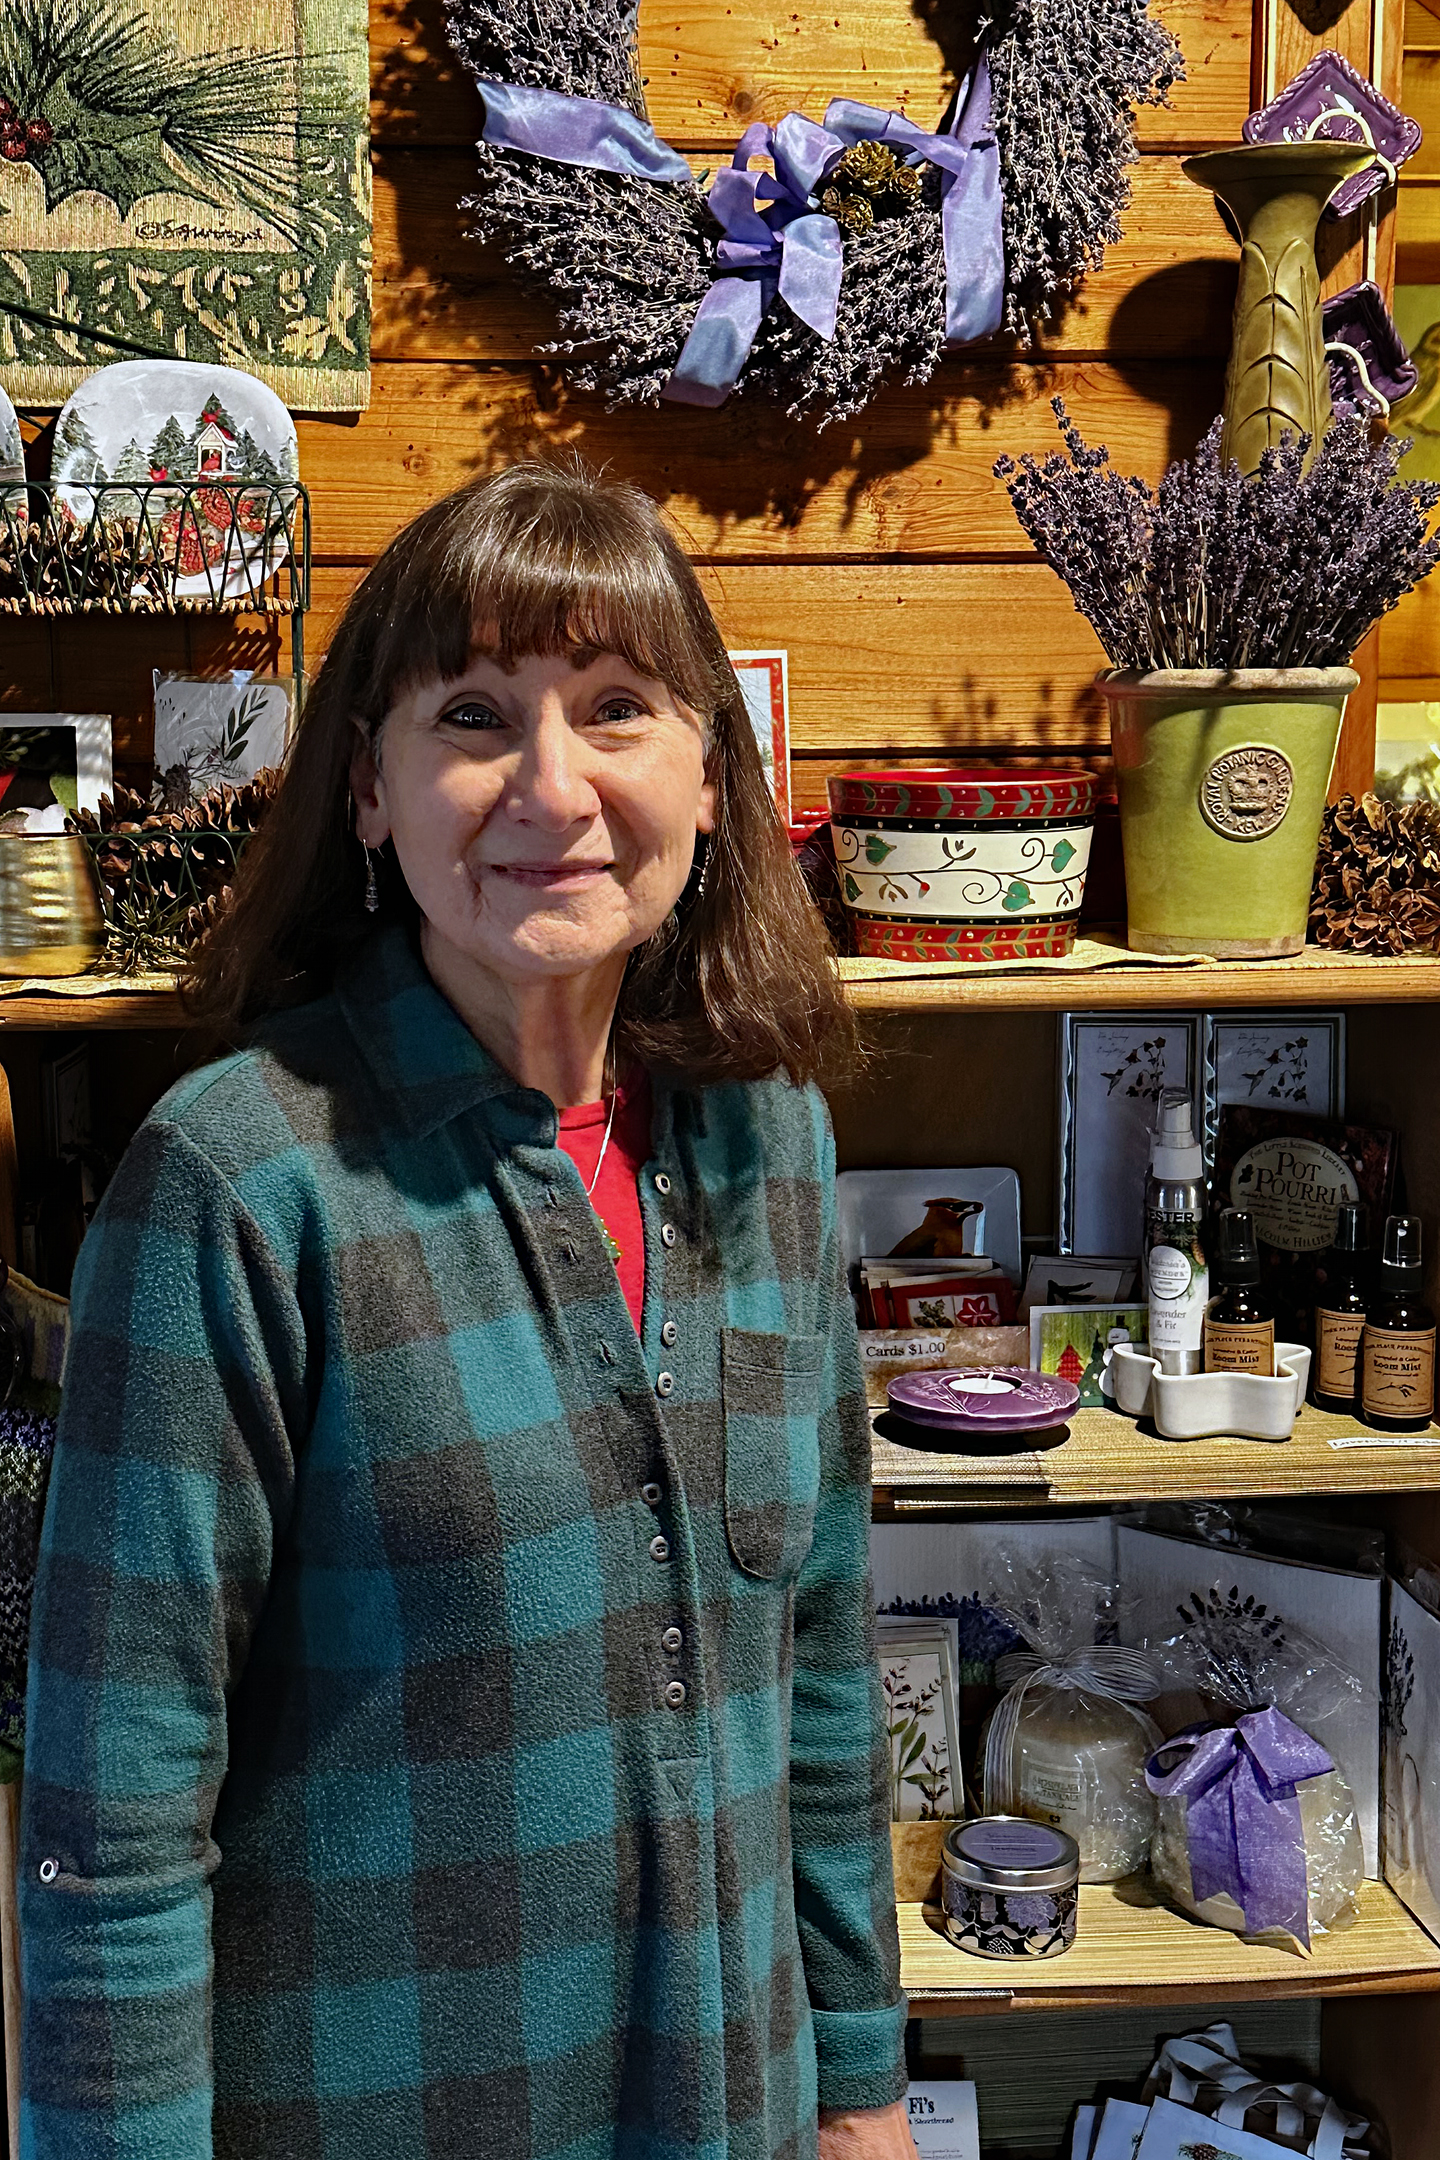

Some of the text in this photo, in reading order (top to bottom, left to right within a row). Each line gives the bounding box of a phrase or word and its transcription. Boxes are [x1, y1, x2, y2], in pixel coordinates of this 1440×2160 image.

[1206, 751, 1290, 822] ROYAL BOTANIC GARDENS
[1275, 1151, 1322, 1181] POT
[1254, 1167, 1336, 1205] POURRI
[1149, 1211, 1195, 1223] ESTER
[866, 1342, 946, 1357] Cards $1.00
